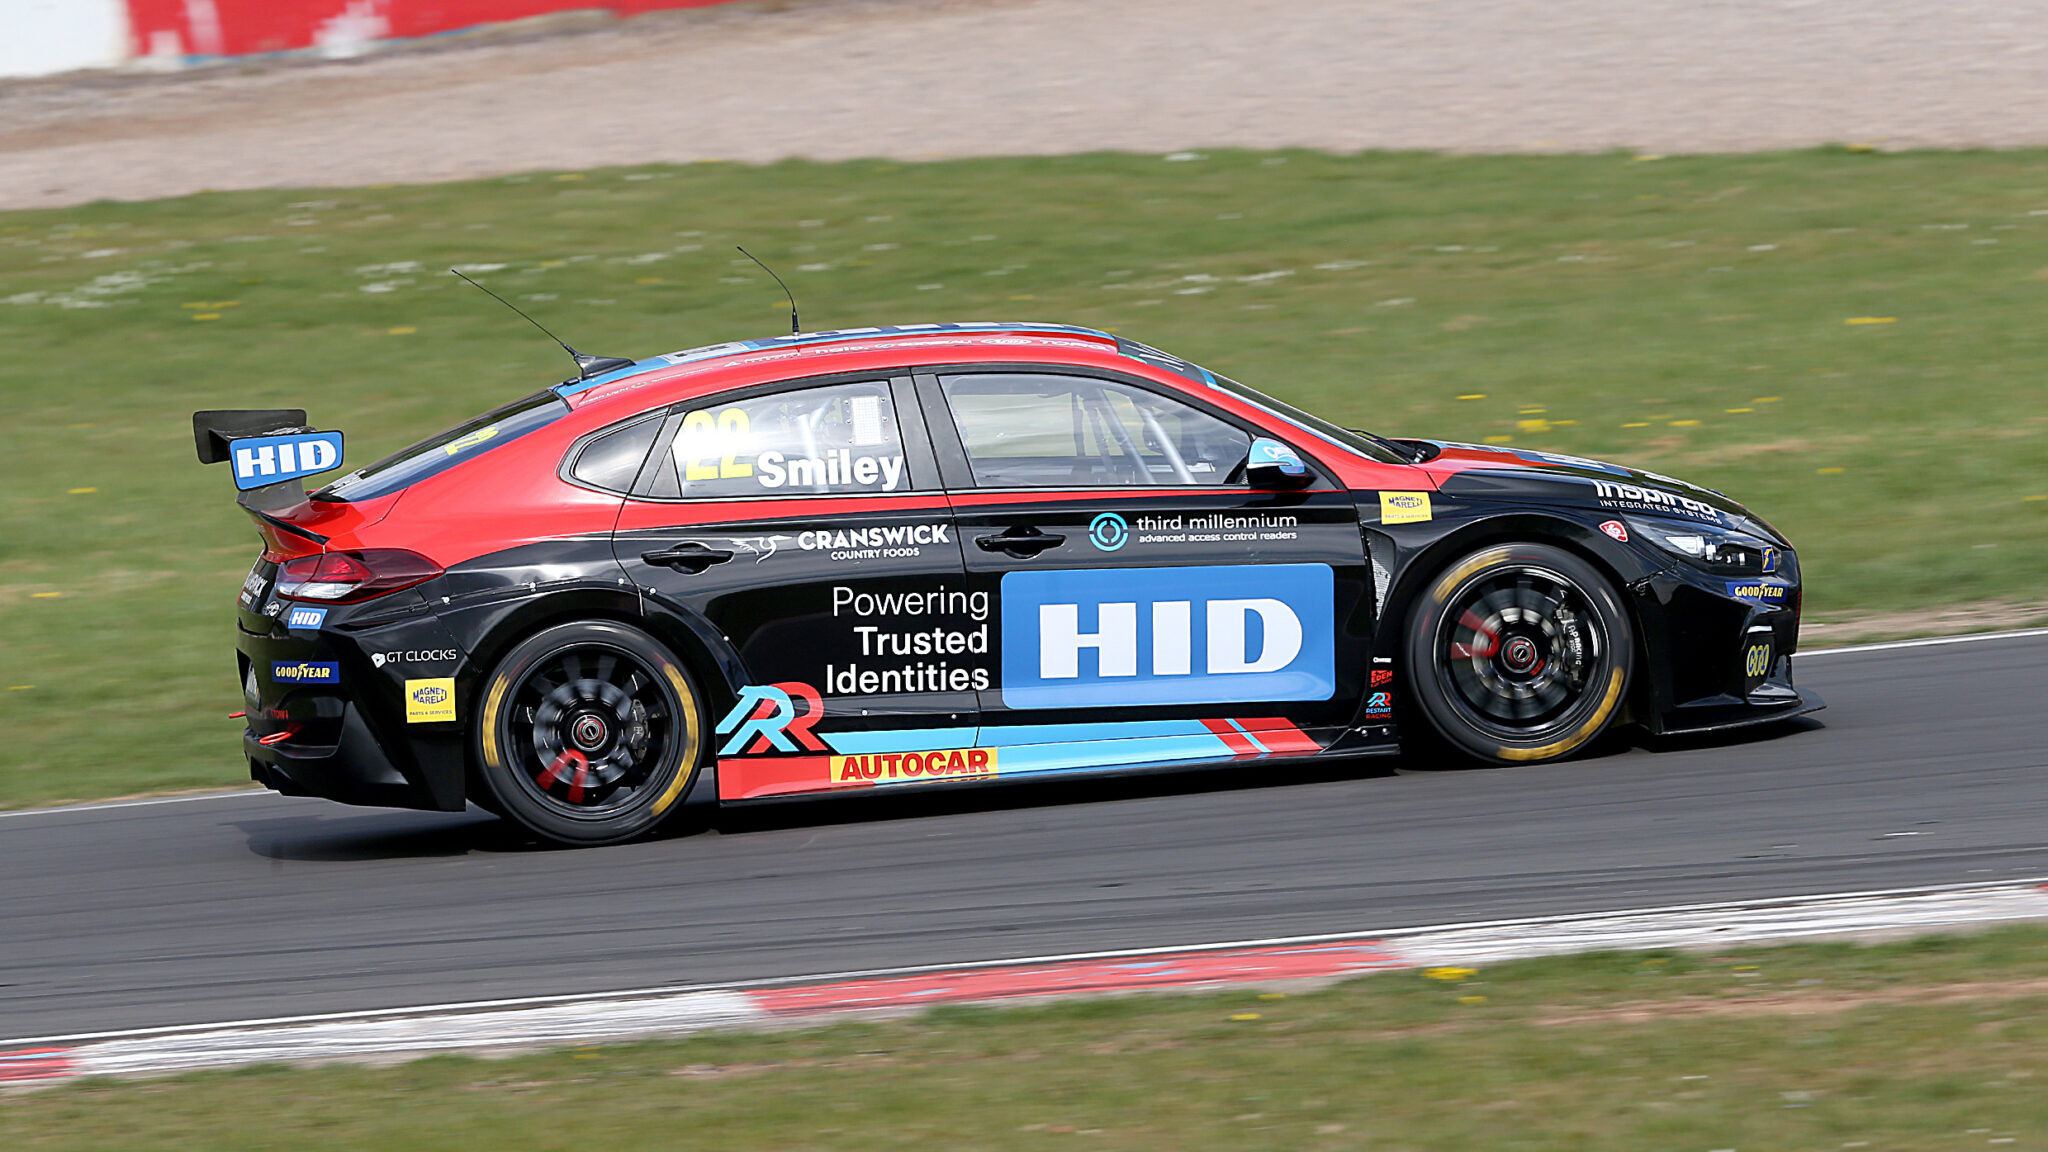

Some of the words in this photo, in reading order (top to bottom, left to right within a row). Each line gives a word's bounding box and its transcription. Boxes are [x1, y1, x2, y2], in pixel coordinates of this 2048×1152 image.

[236, 439, 337, 478] HID
[682, 407, 753, 481] 22
[757, 448, 904, 492] Smiley
[1136, 515, 1182, 531] third
[1189, 513, 1298, 530] millennium
[1600, 500, 1670, 512] INTEGRATED
[1672, 507, 1723, 525] SYSTEMS
[797, 524, 950, 551] CRANSWICK
[1139, 533, 1185, 543] advanced
[1188, 533, 1221, 542] access
[1223, 531, 1257, 541] control
[1260, 531, 1298, 540] readers
[830, 548, 880, 561] COUNTRY
[883, 547, 920, 557] FOODS
[833, 585, 989, 621] Powering
[291, 612, 321, 626] HID
[853, 624, 988, 656] Trusted
[1039, 598, 1303, 679] HID
[386, 651, 403, 663] GT
[405, 649, 457, 662] CLOCKS
[826, 661, 990, 694] Identities
[840, 750, 990, 781] AUTOCAR
